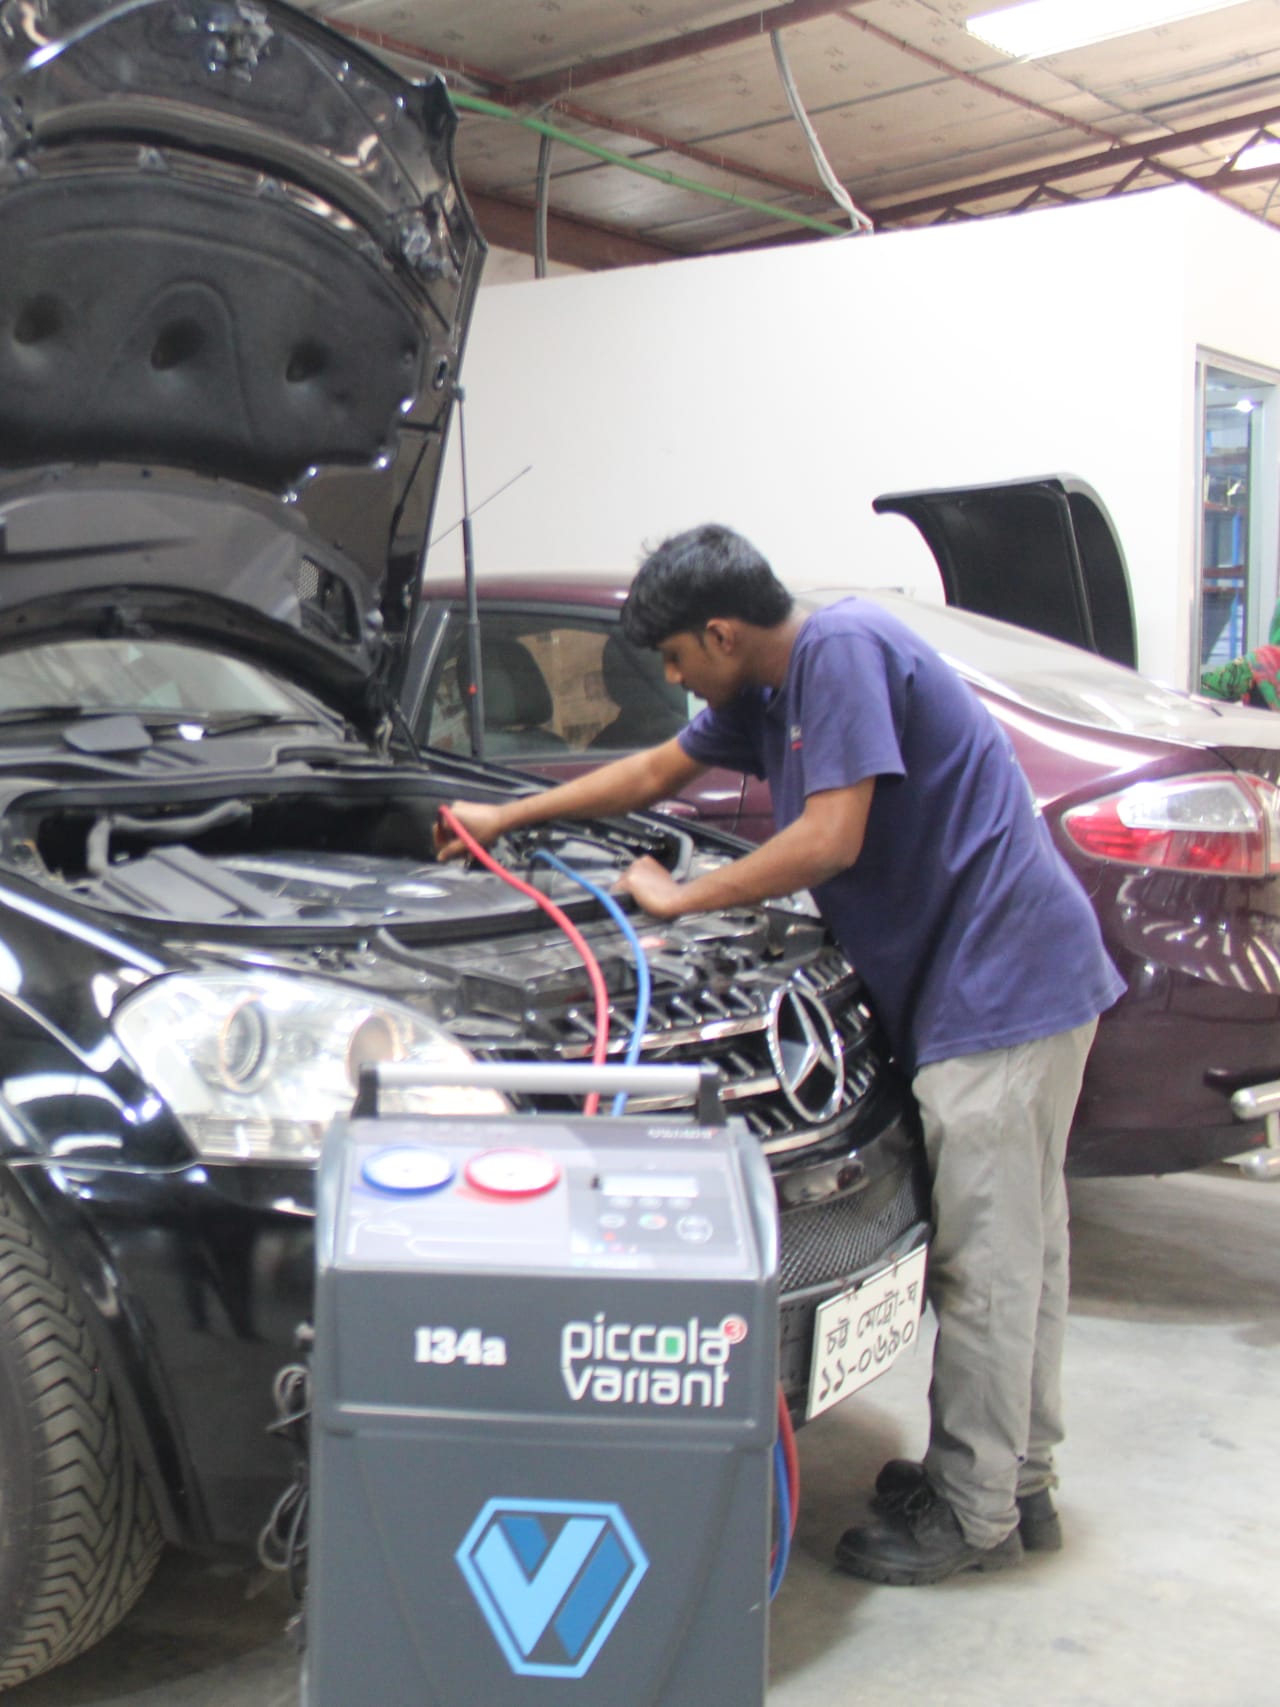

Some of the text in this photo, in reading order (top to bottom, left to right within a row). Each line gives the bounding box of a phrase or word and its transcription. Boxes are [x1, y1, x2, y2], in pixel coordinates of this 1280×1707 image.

[414, 1325, 507, 1366] 134a
[561, 1311, 732, 1368] piccola
[561, 1364, 730, 1408] variant
